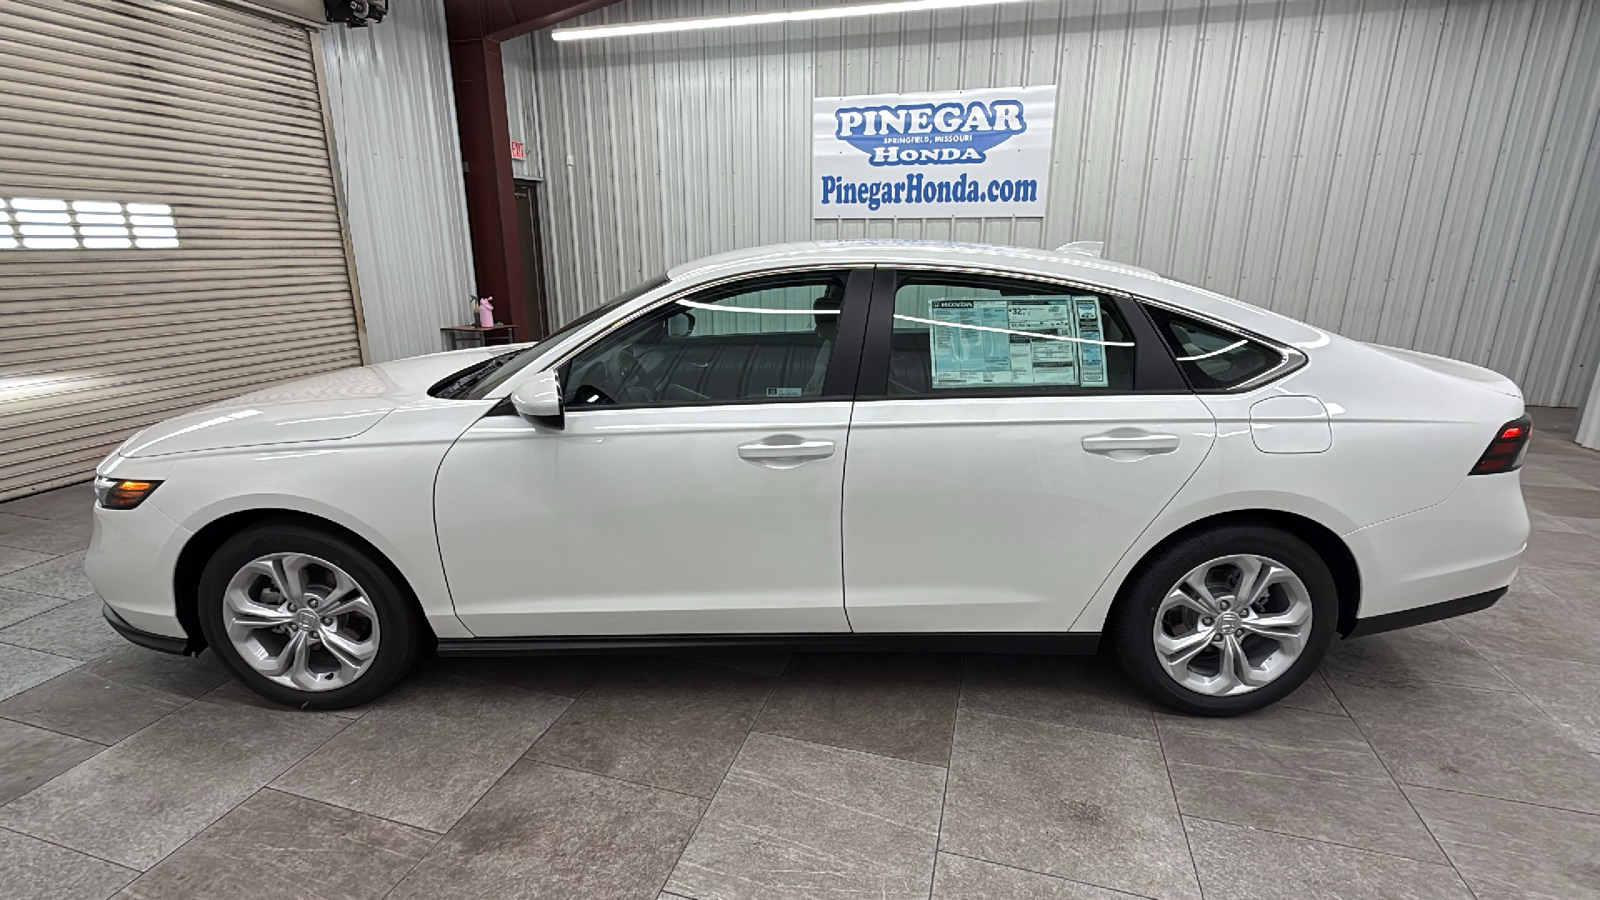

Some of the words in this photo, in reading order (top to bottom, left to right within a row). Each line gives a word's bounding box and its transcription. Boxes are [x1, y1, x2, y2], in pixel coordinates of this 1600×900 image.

[839, 104, 1022, 137] PINEGAR
[883, 136, 932, 144] SPRINGFIELD,
[934, 135, 973, 143] MISSOURI
[511, 141, 524, 158] EXIT
[872, 146, 982, 163] HONDA
[821, 173, 1038, 211] PinegarHonda.com
[1012, 307, 1022, 315] 32
